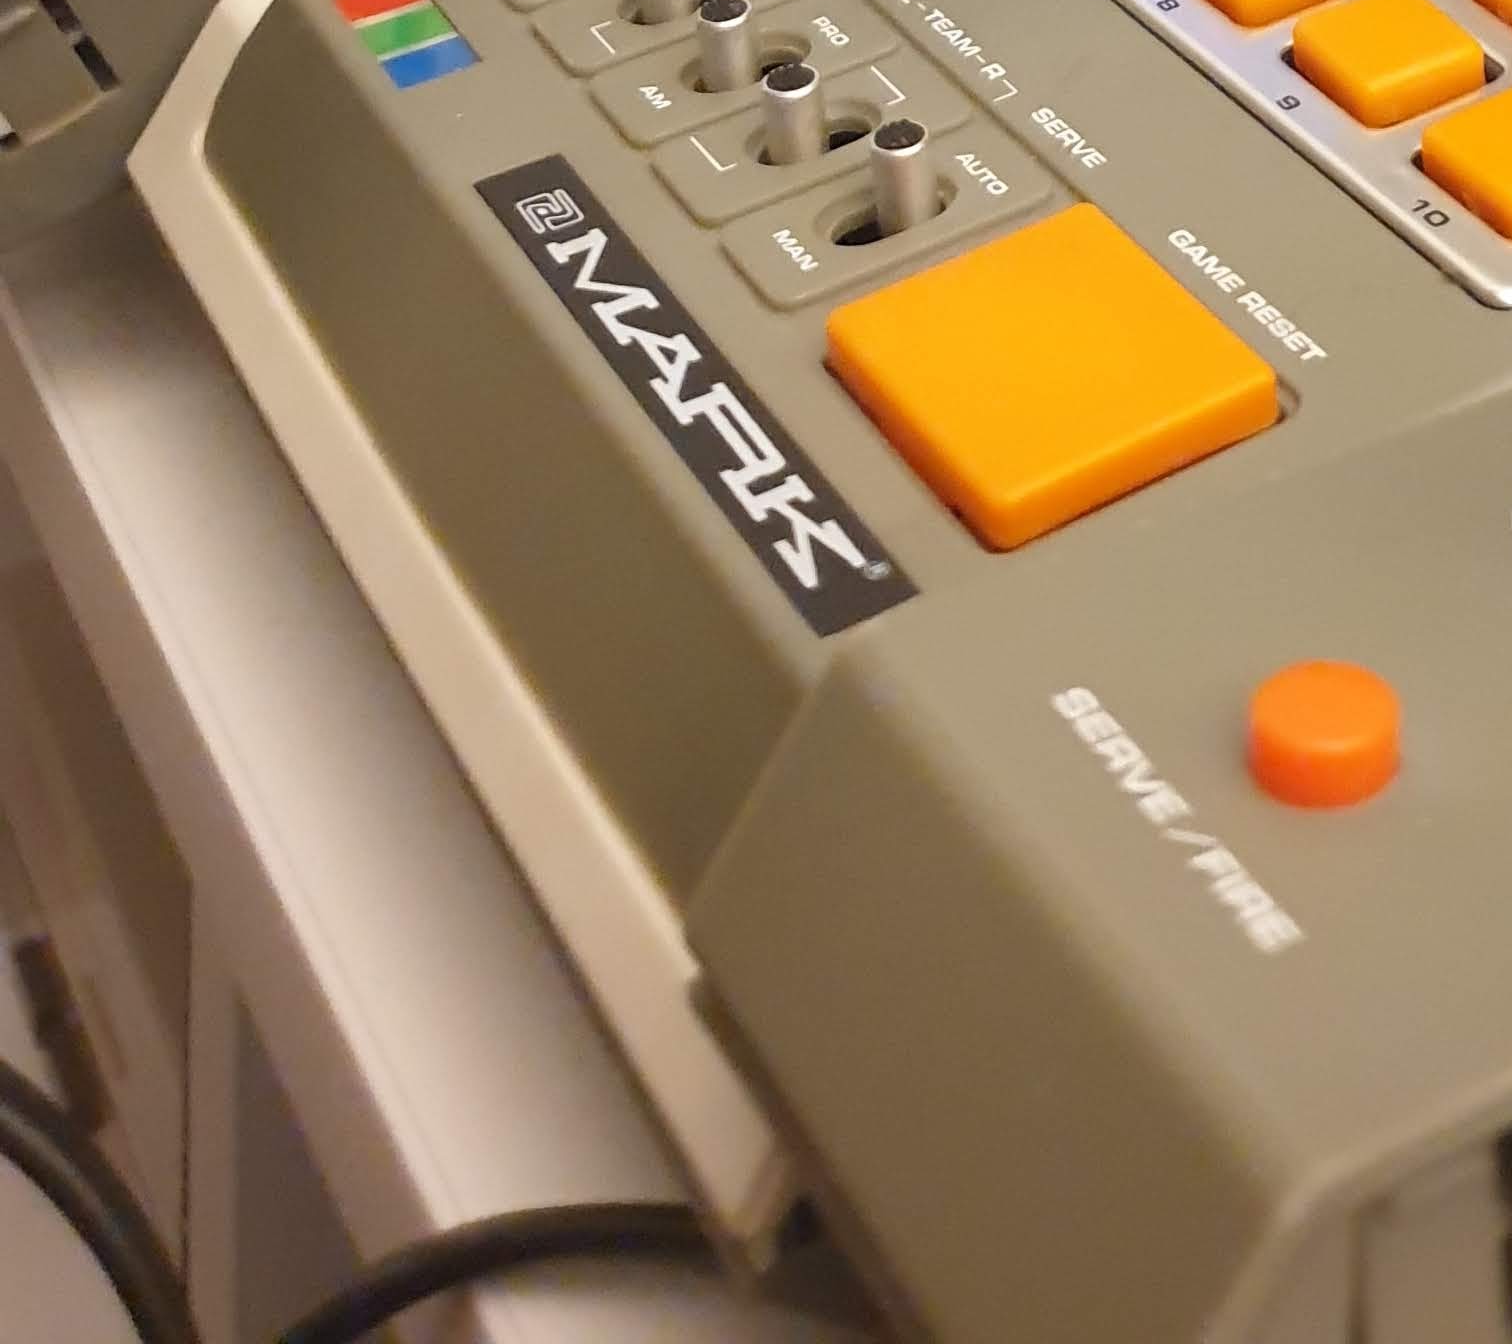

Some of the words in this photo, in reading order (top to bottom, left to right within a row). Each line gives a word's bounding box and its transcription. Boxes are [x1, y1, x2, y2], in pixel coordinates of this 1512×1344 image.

[811, 15, 850, 47] PRO
[638, 84, 672, 110] AM
[1275, 95, 1301, 110] 9
[1031, 107, 1108, 169] SERVE
[955, 152, 1009, 196] AUTO
[1411, 197, 1450, 228] 10
[771, 227, 819, 272] MAN
[1167, 229, 1246, 293] GAME
[1237, 291, 1329, 361] RESET
[545, 227, 868, 590] MARK
